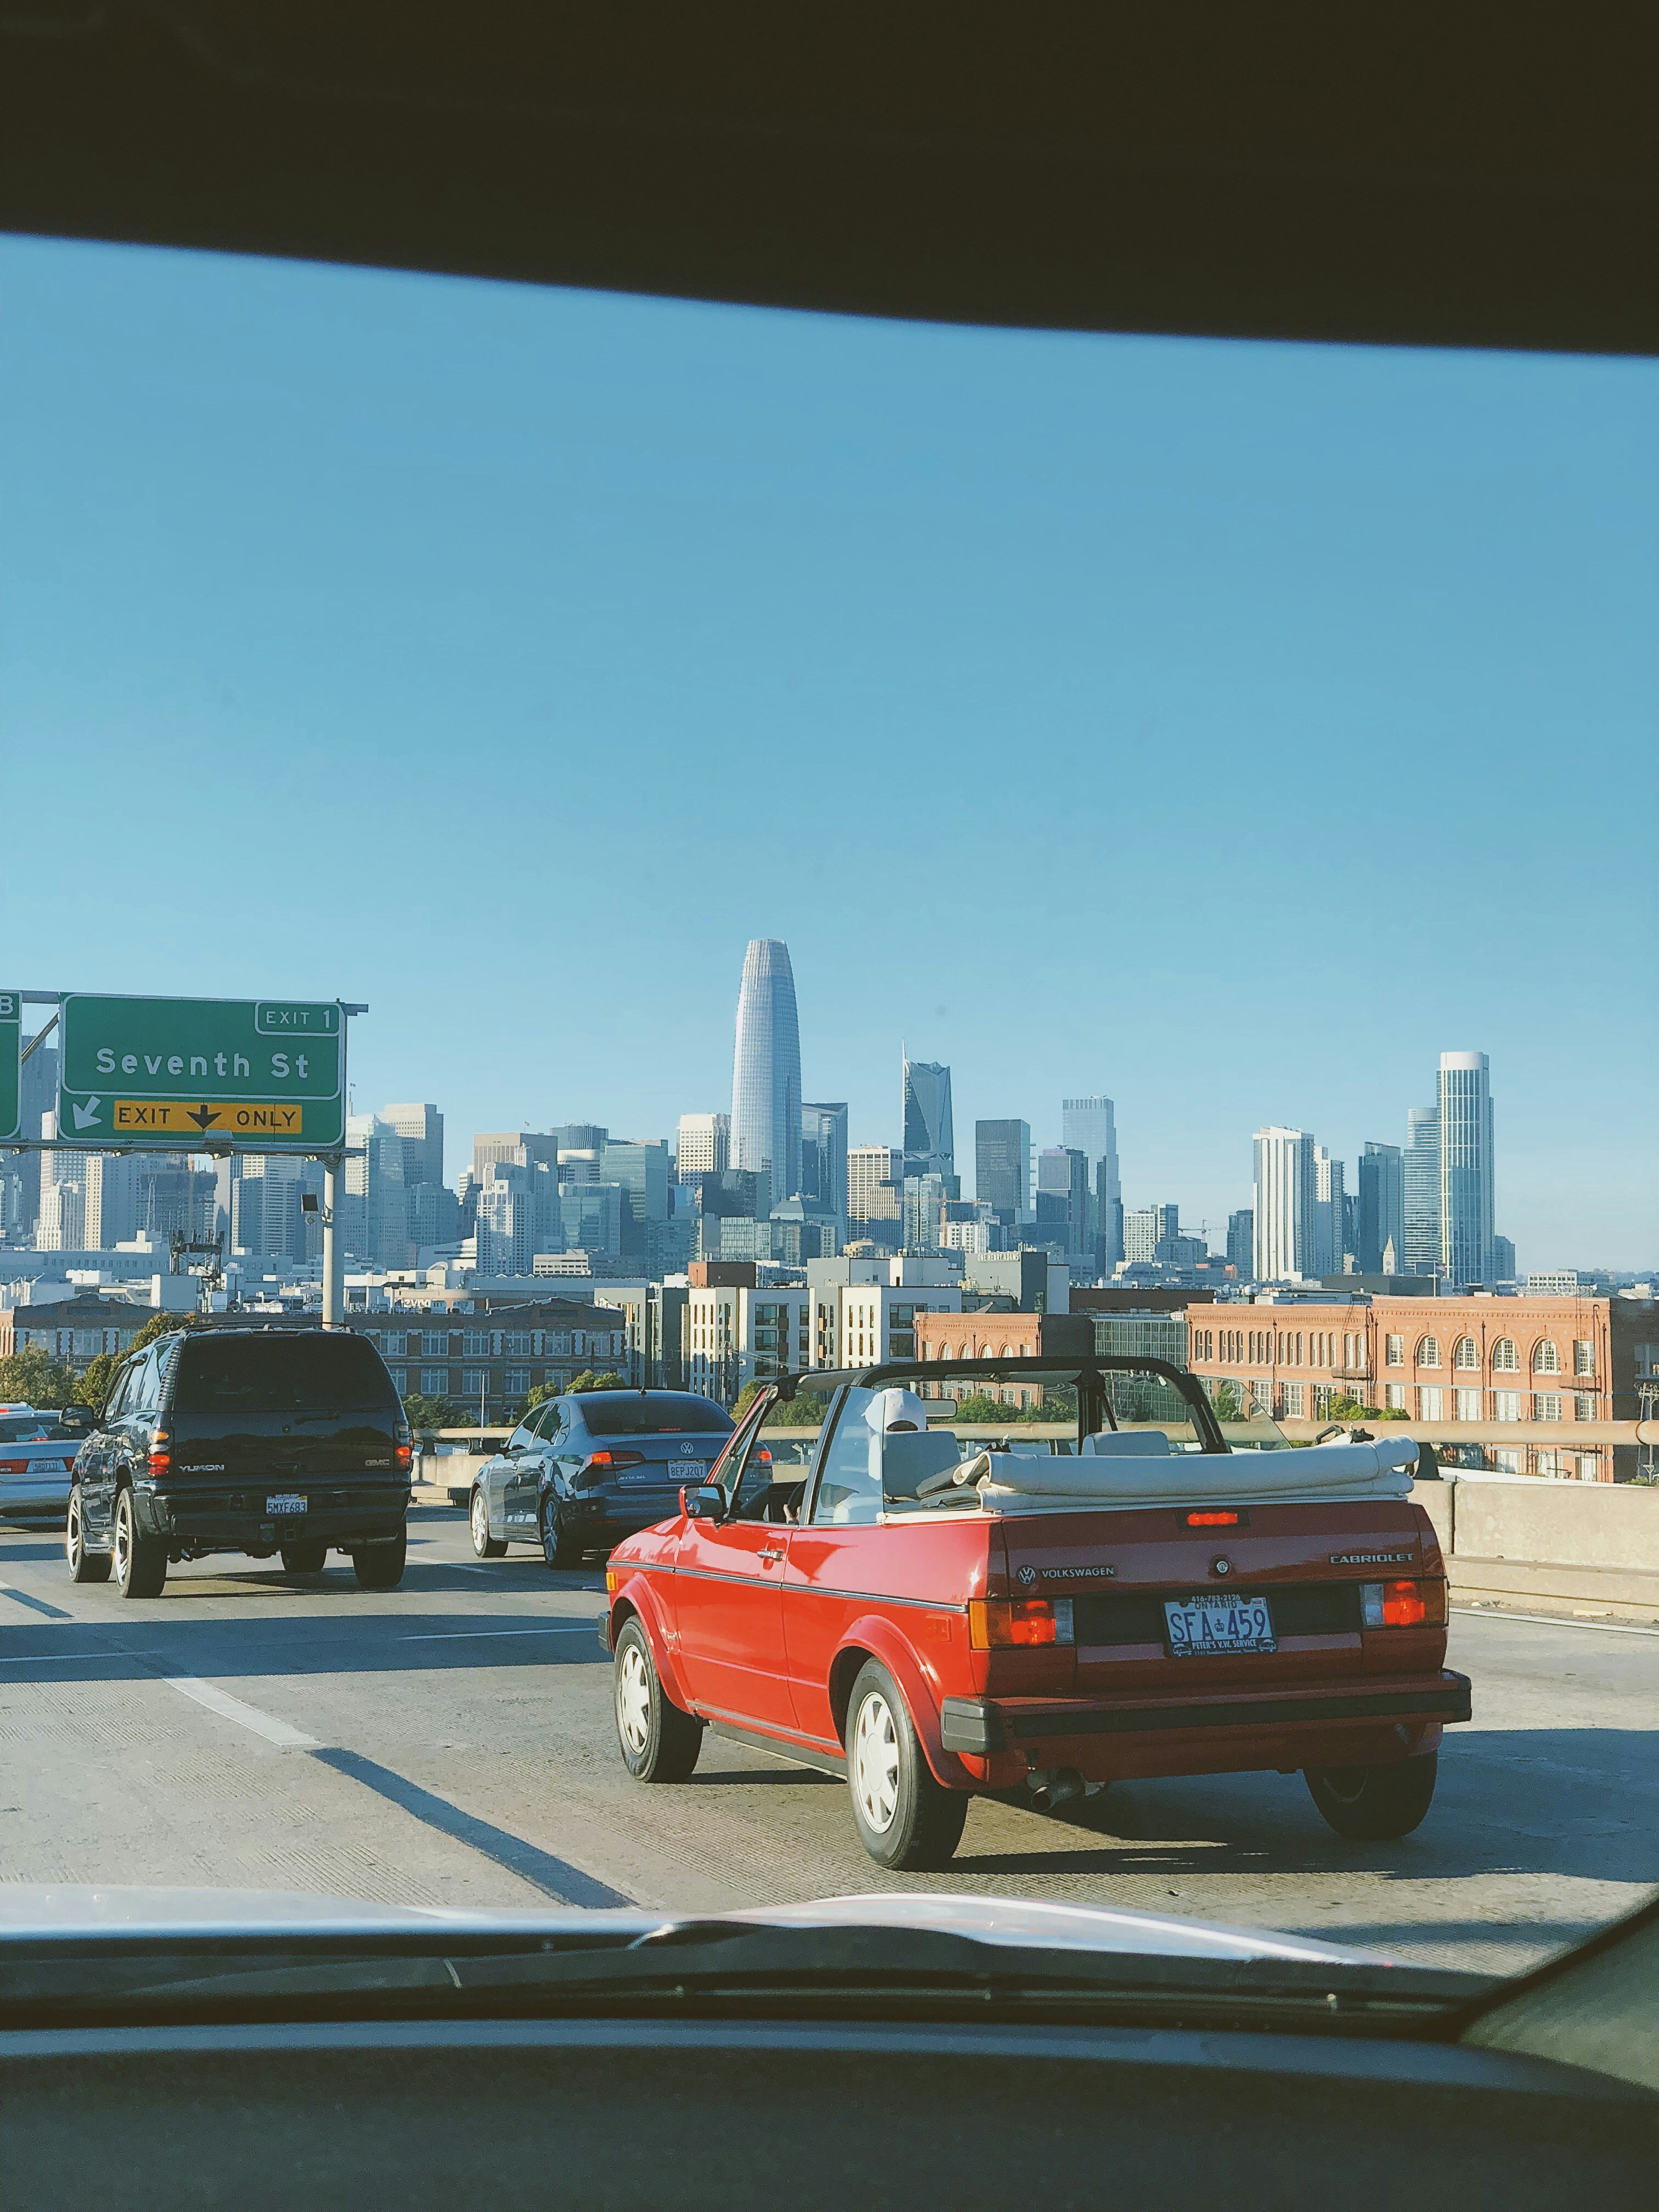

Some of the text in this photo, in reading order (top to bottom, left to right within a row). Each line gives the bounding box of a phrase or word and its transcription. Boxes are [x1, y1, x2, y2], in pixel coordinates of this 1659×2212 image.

[266, 1009, 330, 1028] EXIT 1
[95, 1047, 308, 1079] Seventh St
[118, 1107, 296, 1127] EXIT ONLY
[988, 1253, 1002, 1261] HENRY
[1003, 1252, 1019, 1261] ADAMS
[178, 1464, 224, 1472] YUKON
[267, 1502, 306, 1514] 5MXF683
[1330, 1553, 1414, 1564] CABRIOLET
[1042, 1567, 1115, 1578] VOLKSWAGEN
[1194, 1600, 1238, 1610] ONTARIO
[1170, 1608, 1266, 1642] SFA 459
[1192, 1639, 1257, 1650] PETER'S V.W. SERVICE
